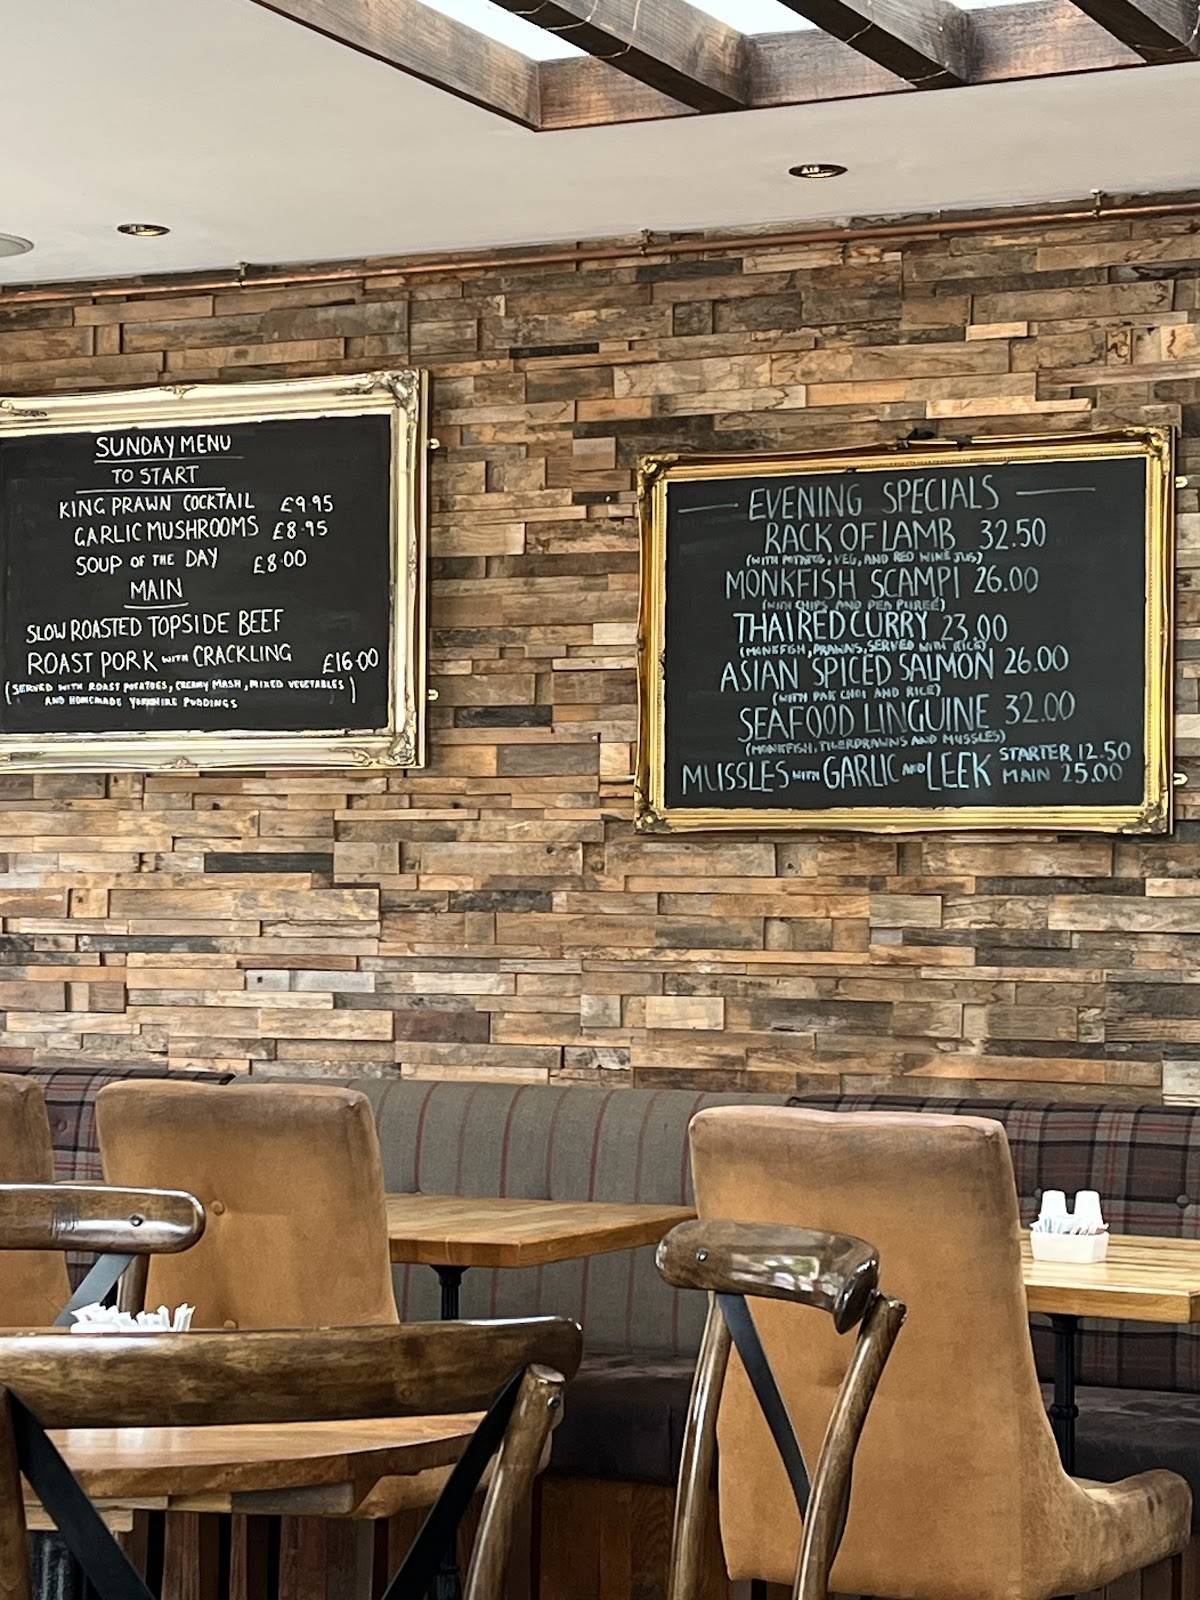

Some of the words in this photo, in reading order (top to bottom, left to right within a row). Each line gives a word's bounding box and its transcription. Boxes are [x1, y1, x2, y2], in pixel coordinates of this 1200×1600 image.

[95, 436, 175, 457] SUNDAY
[180, 434, 231, 453] MENU
[111, 469, 134, 484] TO
[140, 465, 199, 485] START
[59, 496, 105, 519] KING
[111, 495, 171, 516] PRAWN
[183, 492, 255, 511] COCKTAIL
[280, 494, 334, 513] £9.95
[748, 483, 863, 521] EVENING
[882, 474, 1000, 514] SPECIALS
[75, 521, 142, 547] GARLIC
[147, 515, 259, 541] MUSHROOMS
[272, 520, 328, 540] £8.95
[764, 521, 833, 554] RACK
[840, 521, 878, 552] OF
[882, 517, 956, 552] LAMB
[979, 517, 1047, 550] 32.50
[76, 555, 122, 575] SOUP
[130, 554, 146, 568] OF
[152, 553, 175, 566] THE
[186, 547, 219, 568] DAY
[253, 550, 307, 574] £8.00
[863, 553, 889, 565] AND
[893, 550, 915, 563] RED
[919, 550, 951, 563] WINE
[130, 577, 183, 601] MAIN
[725, 566, 857, 600] MONKFISH
[870, 564, 961, 599] SCAMPI
[973, 564, 1039, 594] 26.00
[795, 600, 828, 612] CHIPS
[835, 600, 862, 612] AND
[26, 622, 66, 643] SLOW
[70, 616, 142, 641] ROASTED
[148, 611, 230, 639] TOPSIDE
[238, 608, 284, 636] BEEF
[732, 610, 794, 644] THAI
[797, 610, 847, 643] RED
[850, 609, 928, 641] CURRY
[940, 613, 1008, 643] 23.00
[867, 638, 915, 653] SERVED
[27, 651, 93, 675] ROAST
[100, 649, 158, 678] PORK
[161, 654, 189, 664] WITH
[193, 643, 292, 667] CRACKLING
[720, 657, 800, 693] ASIAN
[811, 654, 892, 689] SPICED
[900, 647, 995, 683] SALMON
[1003, 644, 1070, 675] 26.00
[57, 682, 83, 691] WITH
[88, 682, 120, 691] ROAST
[249, 679, 284, 689] MIXED
[812, 690, 837, 702] PAK
[874, 687, 900, 699] AND
[44, 696, 65, 706] AND
[68, 696, 122, 707] HOMEMADE
[183, 697, 238, 709] PUDDINGS
[737, 703, 855, 742] SEAFOOD
[863, 693, 990, 735] LINGUINE
[1005, 689, 1076, 725] 32.00
[910, 734, 938, 747] AND
[999, 744, 1072, 762] STARTER
[1078, 741, 1131, 761] 12.50
[682, 759, 790, 795] MUSSLES
[792, 770, 820, 781] WITH
[822, 752, 900, 790] GARLIC
[902, 762, 926, 776] AND
[927, 751, 992, 791] LEEK
[1003, 765, 1051, 785] MAIN
[1060, 762, 1123, 784] 25.00
